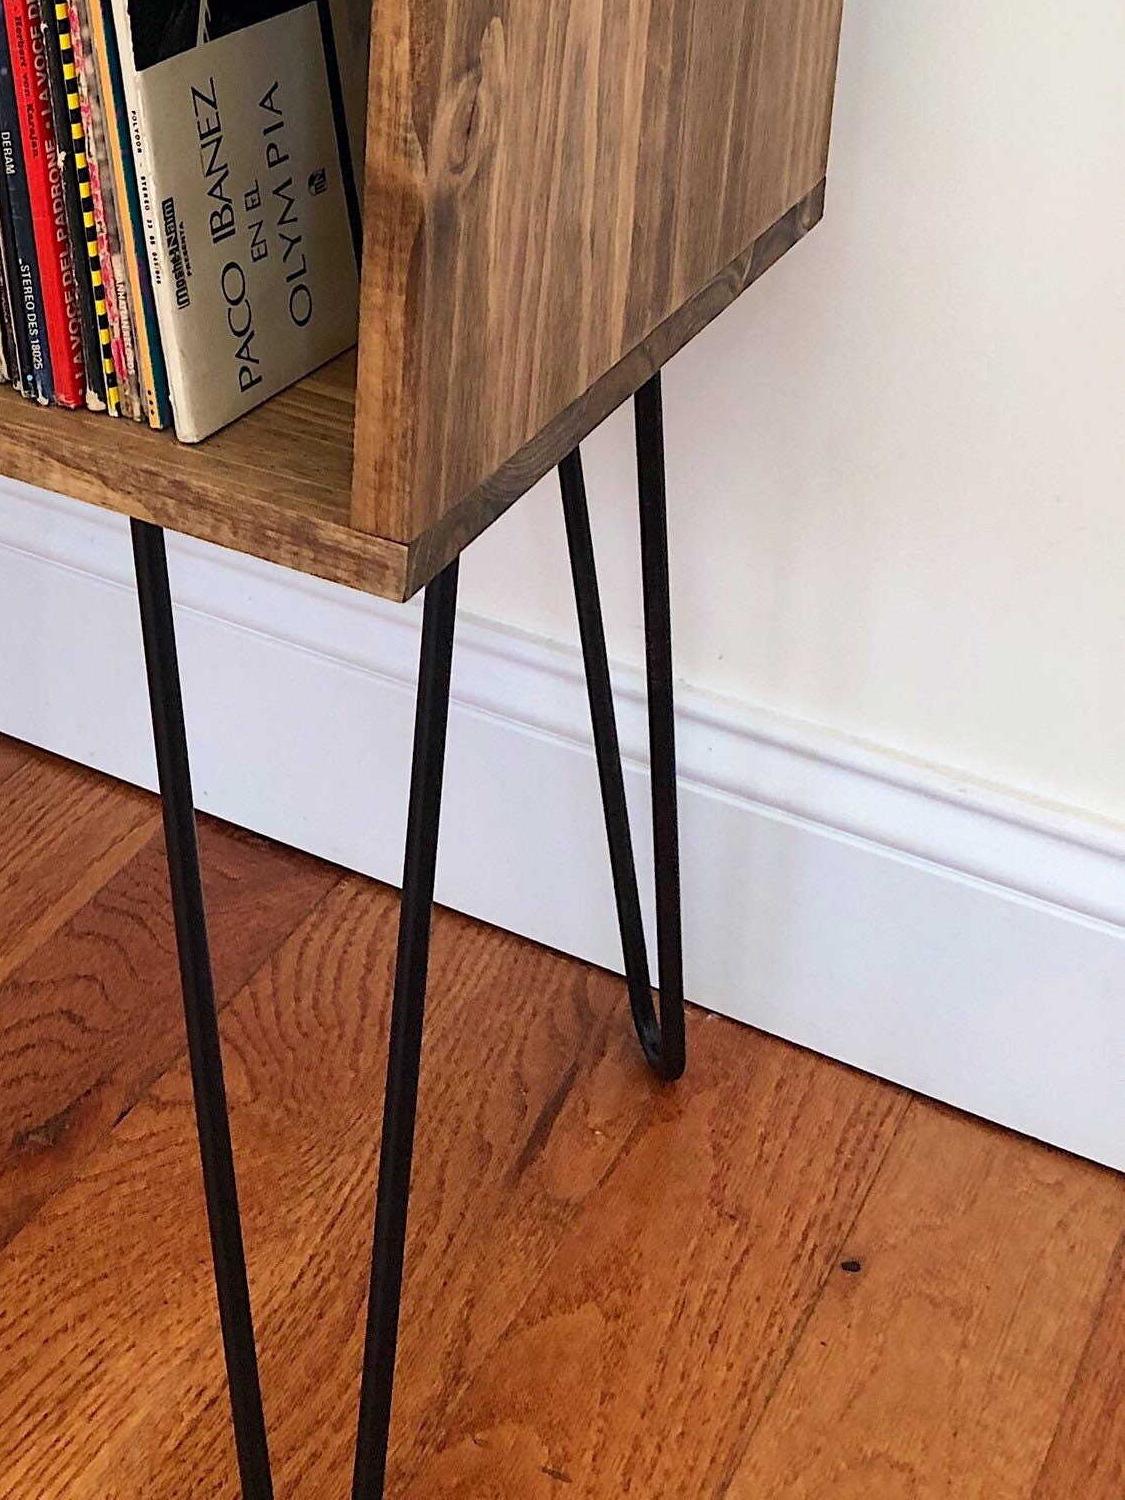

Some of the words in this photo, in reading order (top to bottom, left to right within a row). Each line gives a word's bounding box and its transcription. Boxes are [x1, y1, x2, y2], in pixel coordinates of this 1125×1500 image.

[14, 16, 28, 67] Herbert
[30, 25, 49, 86] VOCE
[1, 132, 15, 175] DERAM
[130, 109, 143, 154] POLYDOR
[140, 176, 152, 211] STEREO
[191, 76, 236, 244] IBANEZ
[45, 139, 69, 241] PADRONE
[244, 179, 259, 210] EL
[258, 81, 313, 327] OLYMPIA
[58, 244, 75, 287] DEL
[179, 221, 193, 277] PRESENTA
[250, 220, 269, 263] EN
[20, 264, 35, 311] STEREO
[27, 313, 39, 336] DES
[64, 291, 83, 349] VOCE
[221, 262, 263, 393] PACO
[31, 339, 44, 370] 18025
